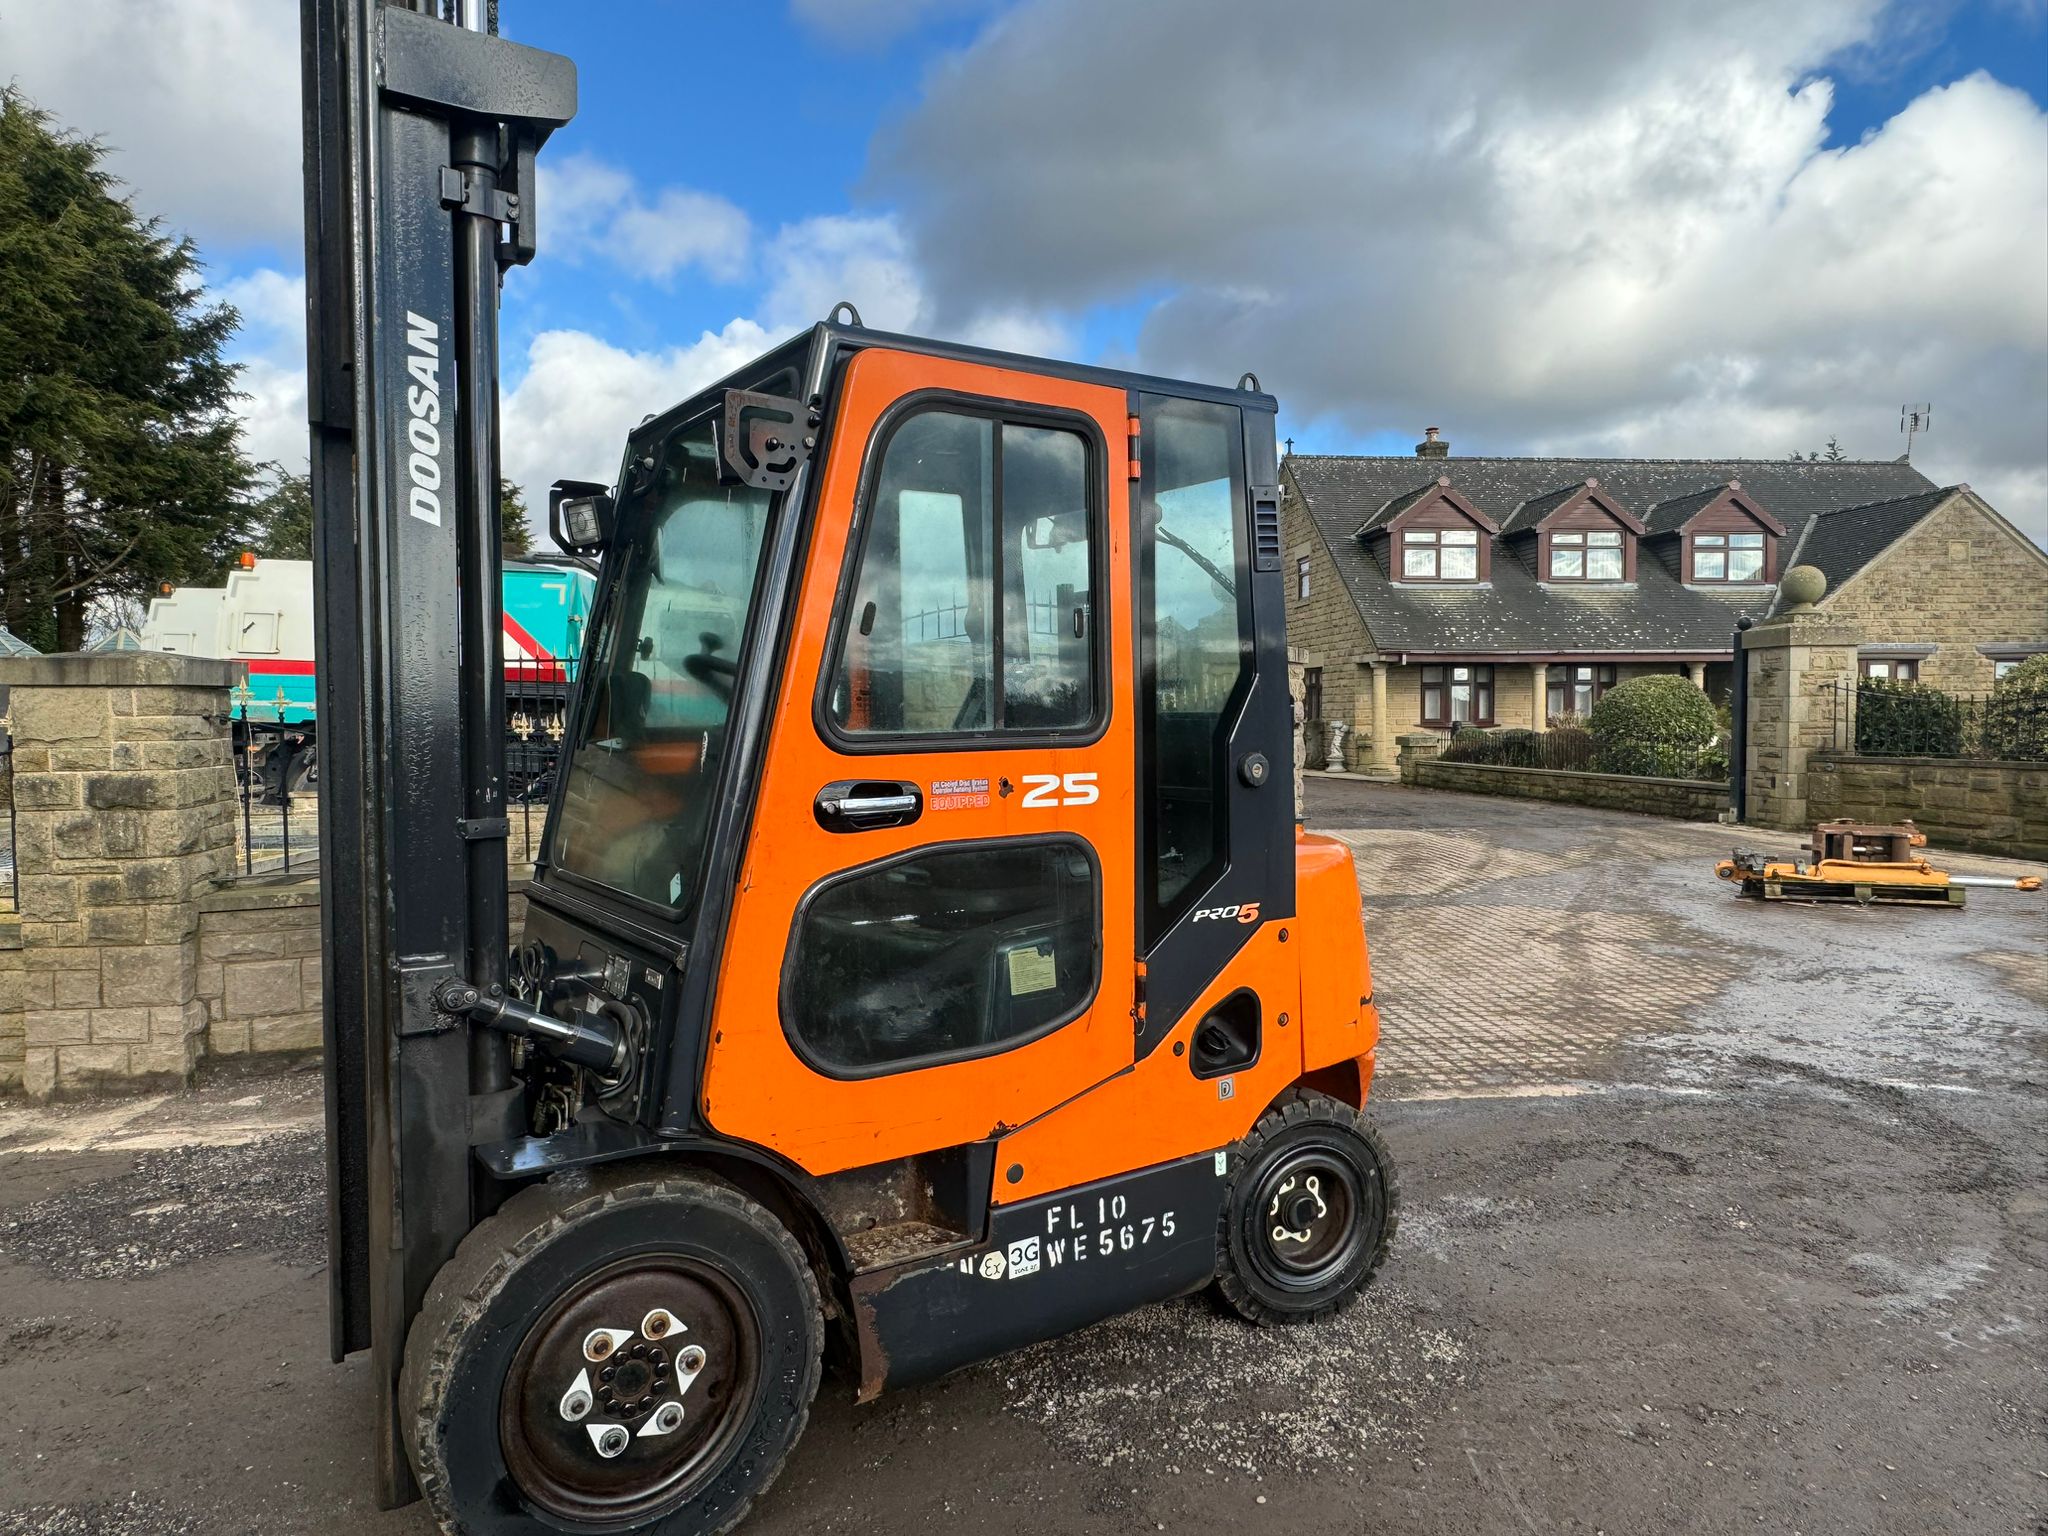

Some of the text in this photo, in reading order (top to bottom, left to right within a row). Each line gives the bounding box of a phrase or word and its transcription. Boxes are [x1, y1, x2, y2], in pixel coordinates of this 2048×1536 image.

[407, 310, 441, 527] DOOSAN
[1022, 772, 1100, 808] 25
[931, 795, 990, 810] EQUIPPED
[1192, 902, 1261, 924] PRO5
[1010, 1242, 1039, 1266] 3G
[984, 1257, 1001, 1277] Ex
